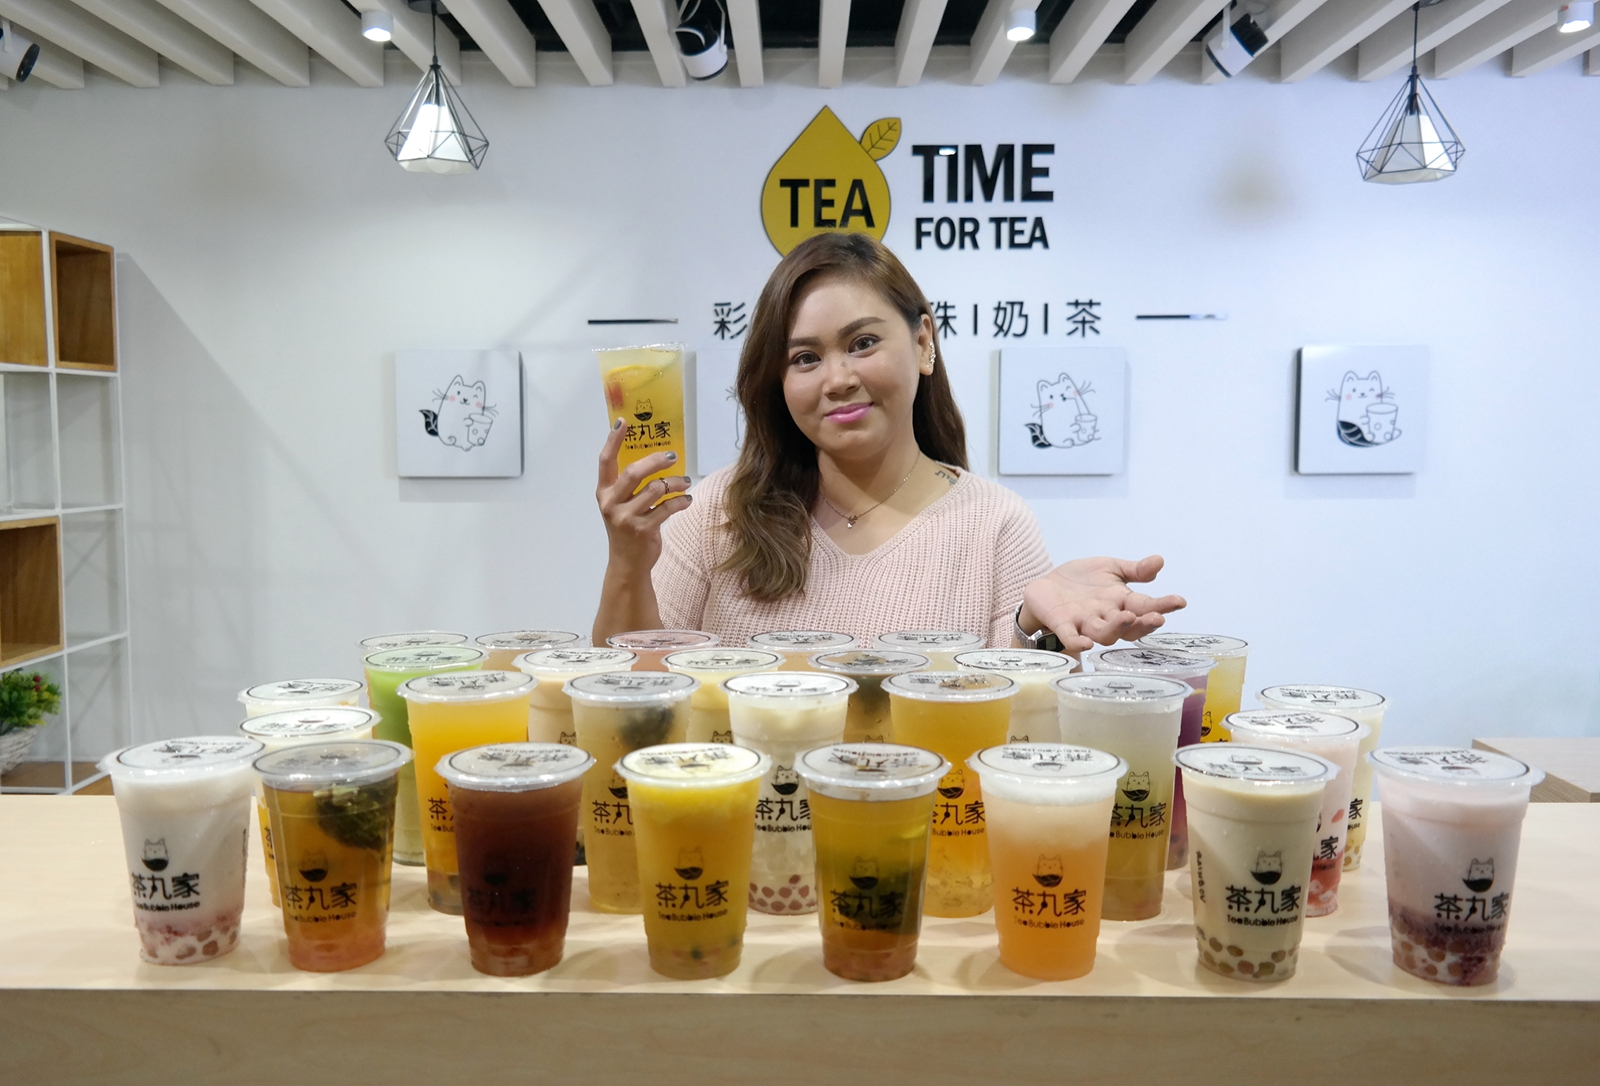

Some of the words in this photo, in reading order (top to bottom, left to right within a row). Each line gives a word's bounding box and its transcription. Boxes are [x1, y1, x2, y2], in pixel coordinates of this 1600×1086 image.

[911, 143, 1056, 204] TIME
[779, 178, 876, 229] TEA
[915, 216, 980, 251] FOR
[988, 216, 1050, 250] TEA
[624, 421, 671, 441] 茶丸家
[132, 872, 200, 901] 茶丸家
[284, 882, 357, 911] 茶丸家
[655, 880, 729, 909] 茶丸家
[1012, 886, 1087, 917] 茶丸家
[1225, 884, 1302, 914] 茶丸家
[830, 889, 904, 919] 茶丸家
[1434, 892, 1510, 922] 茶丸家
